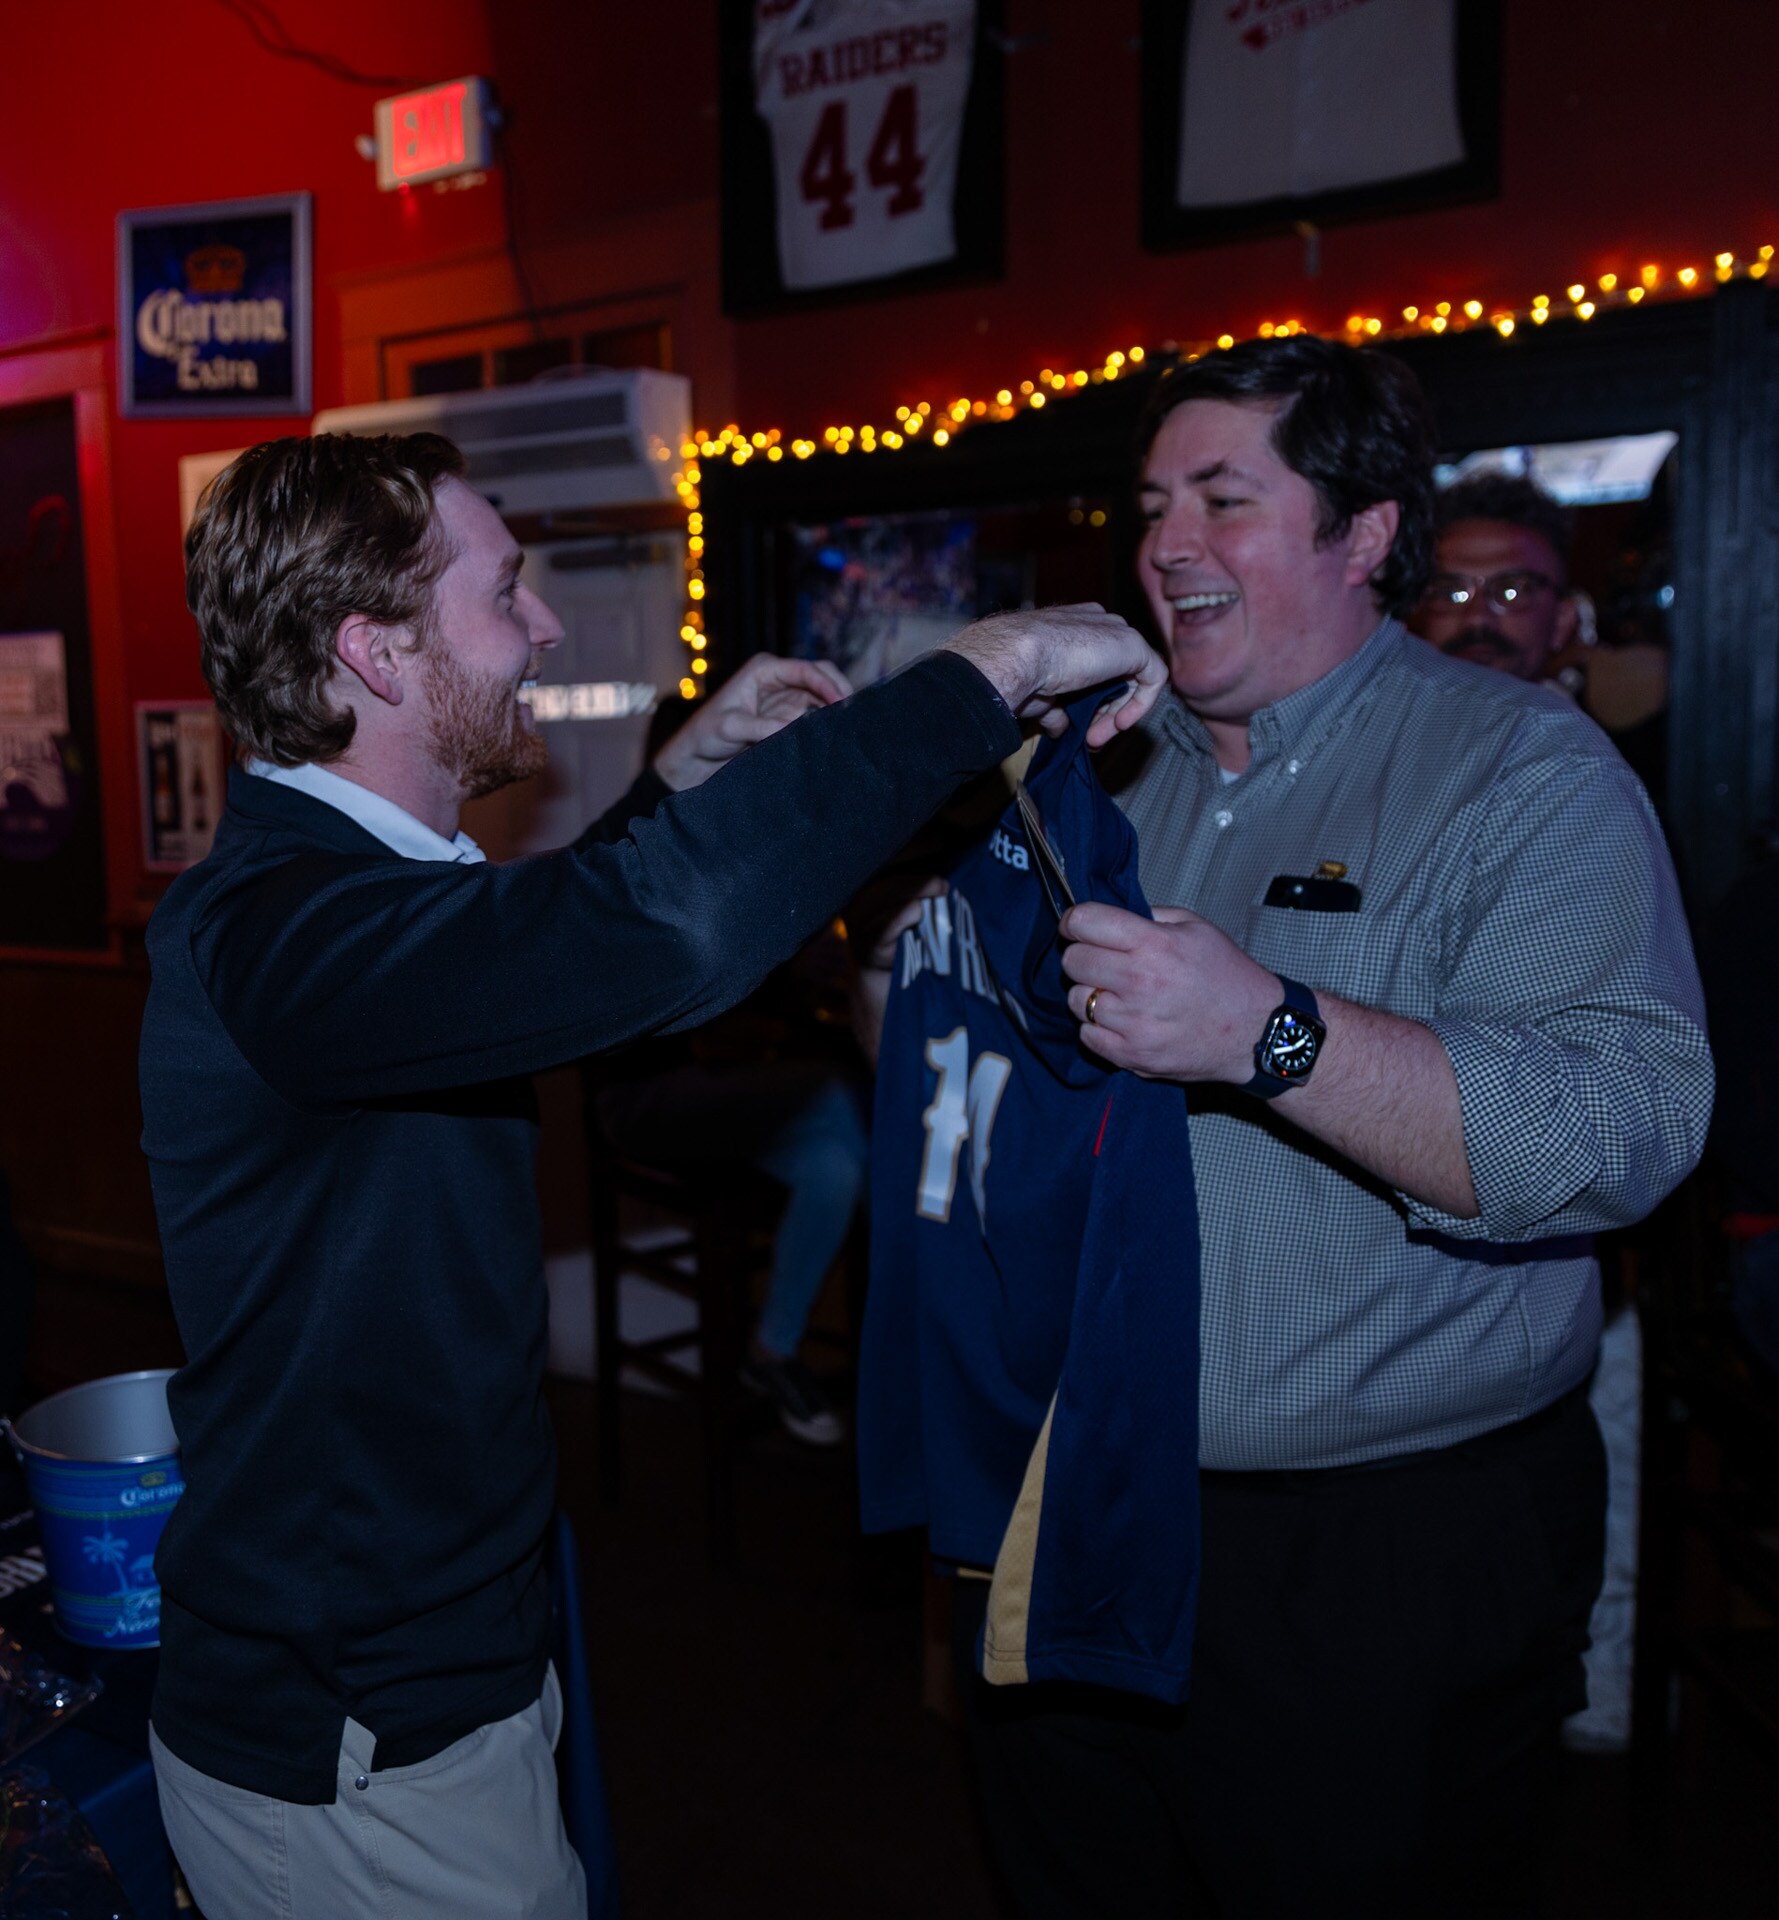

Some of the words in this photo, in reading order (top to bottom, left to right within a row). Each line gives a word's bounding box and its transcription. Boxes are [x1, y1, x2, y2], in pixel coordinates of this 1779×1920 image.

[780, 20, 948, 98] RAIDERS
[392, 83, 467, 177] EXIT
[801, 82, 926, 233] 44
[137, 288, 288, 360] Corona
[177, 348, 259, 390] Extra
